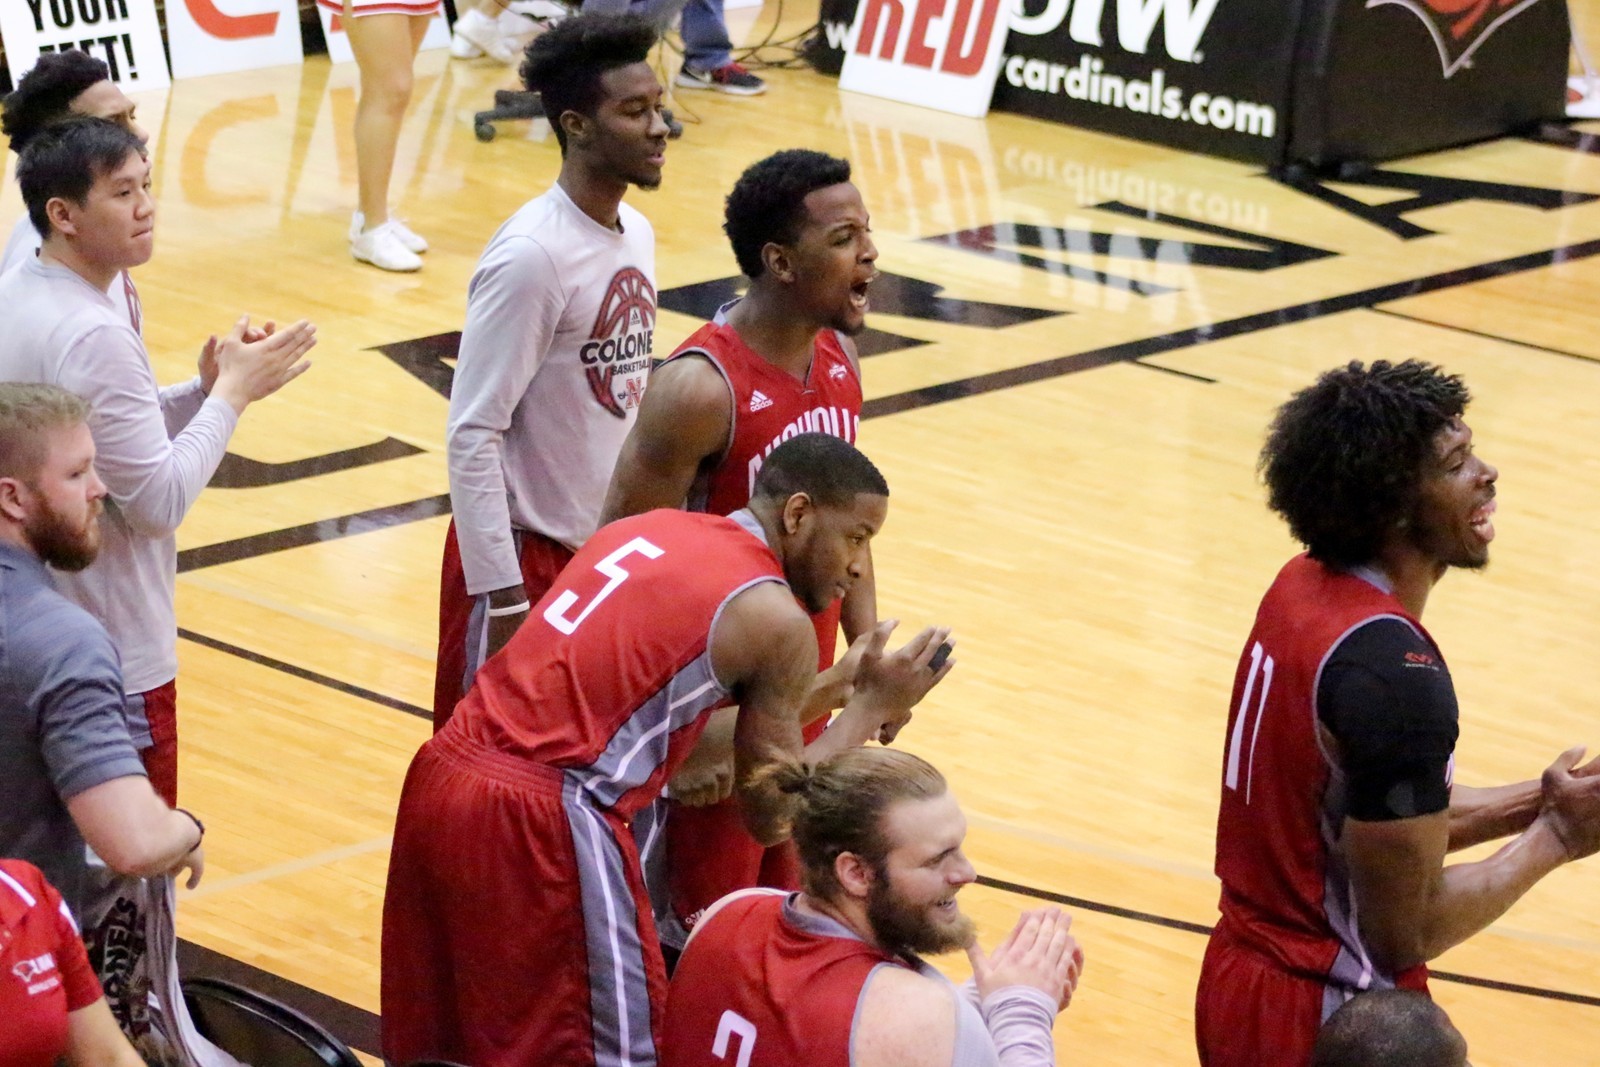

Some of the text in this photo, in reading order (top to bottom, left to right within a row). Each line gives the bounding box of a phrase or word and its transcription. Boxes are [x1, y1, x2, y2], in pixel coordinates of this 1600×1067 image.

[1004, 53, 1277, 138] cardinals.com
[750, 399, 774, 413] adidas
[543, 536, 666, 635] 5
[1225, 640, 1274, 805] 11
